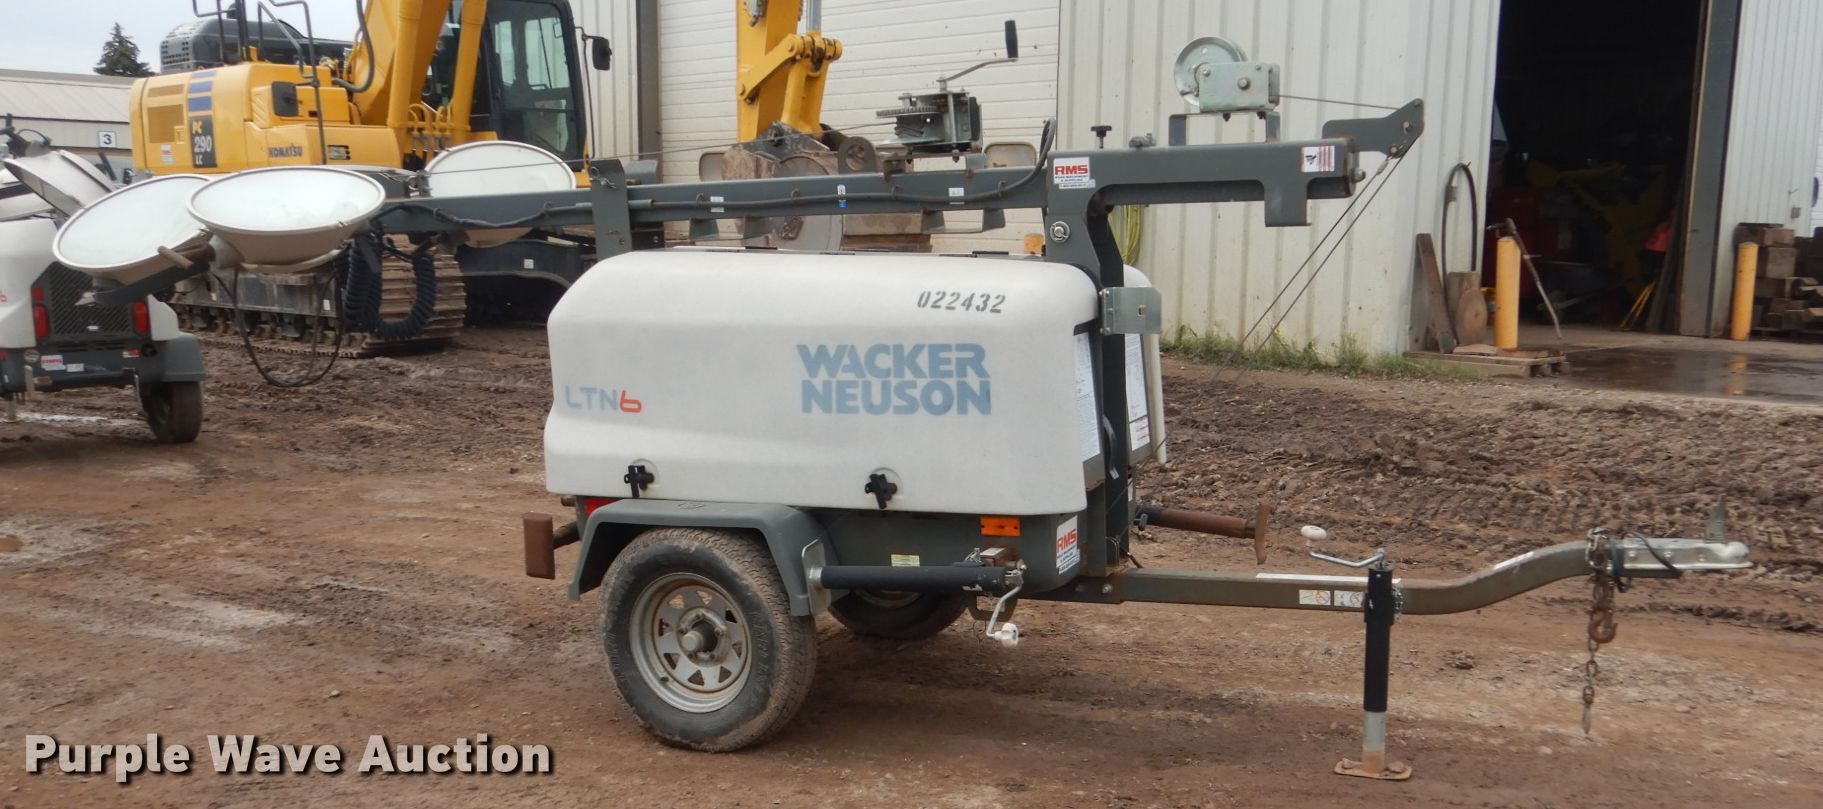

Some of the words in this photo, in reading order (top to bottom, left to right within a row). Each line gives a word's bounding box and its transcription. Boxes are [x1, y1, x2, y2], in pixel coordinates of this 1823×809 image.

[192, 121, 202, 134] PC
[103, 134, 112, 145] 3
[194, 136, 212, 153] 290
[195, 154, 203, 165] LC
[268, 145, 303, 158] KOMATSU
[1055, 165, 1088, 175] RMS
[917, 290, 1006, 314] 022432
[797, 343, 991, 379] WACKER
[565, 385, 642, 413] LTN6
[801, 379, 992, 415] NEUSON
[1056, 528, 1076, 555] RMS
